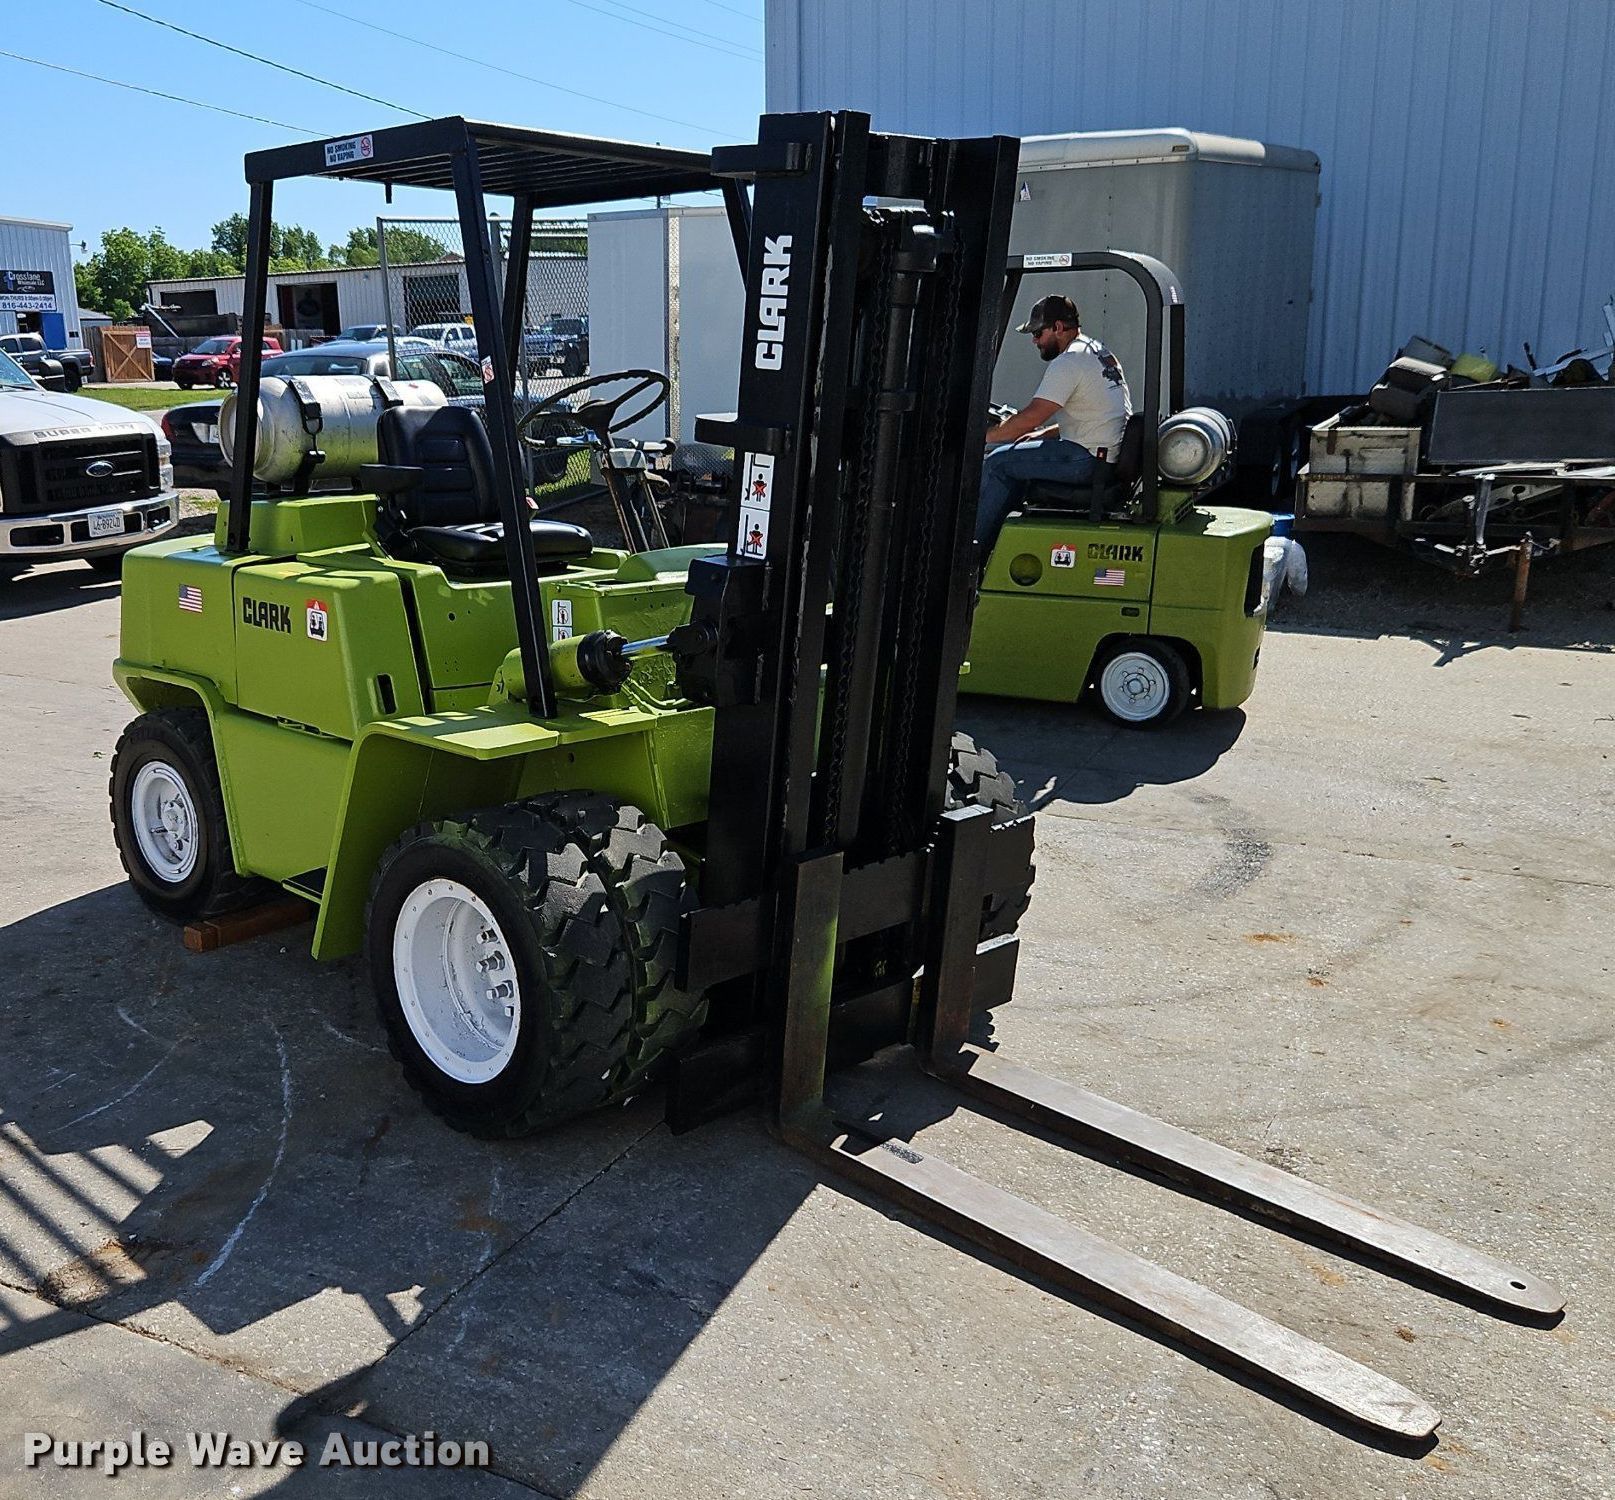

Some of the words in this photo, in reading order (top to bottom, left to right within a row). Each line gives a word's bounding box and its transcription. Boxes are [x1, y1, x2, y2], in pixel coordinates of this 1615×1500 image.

[327, 145, 334, 155] NO
[335, 141, 357, 153] SMOKING
[329, 153, 337, 163] NO
[755, 235, 793, 371] CLARK
[1087, 543, 1144, 562] CLARK
[243, 597, 291, 634] CLARK
